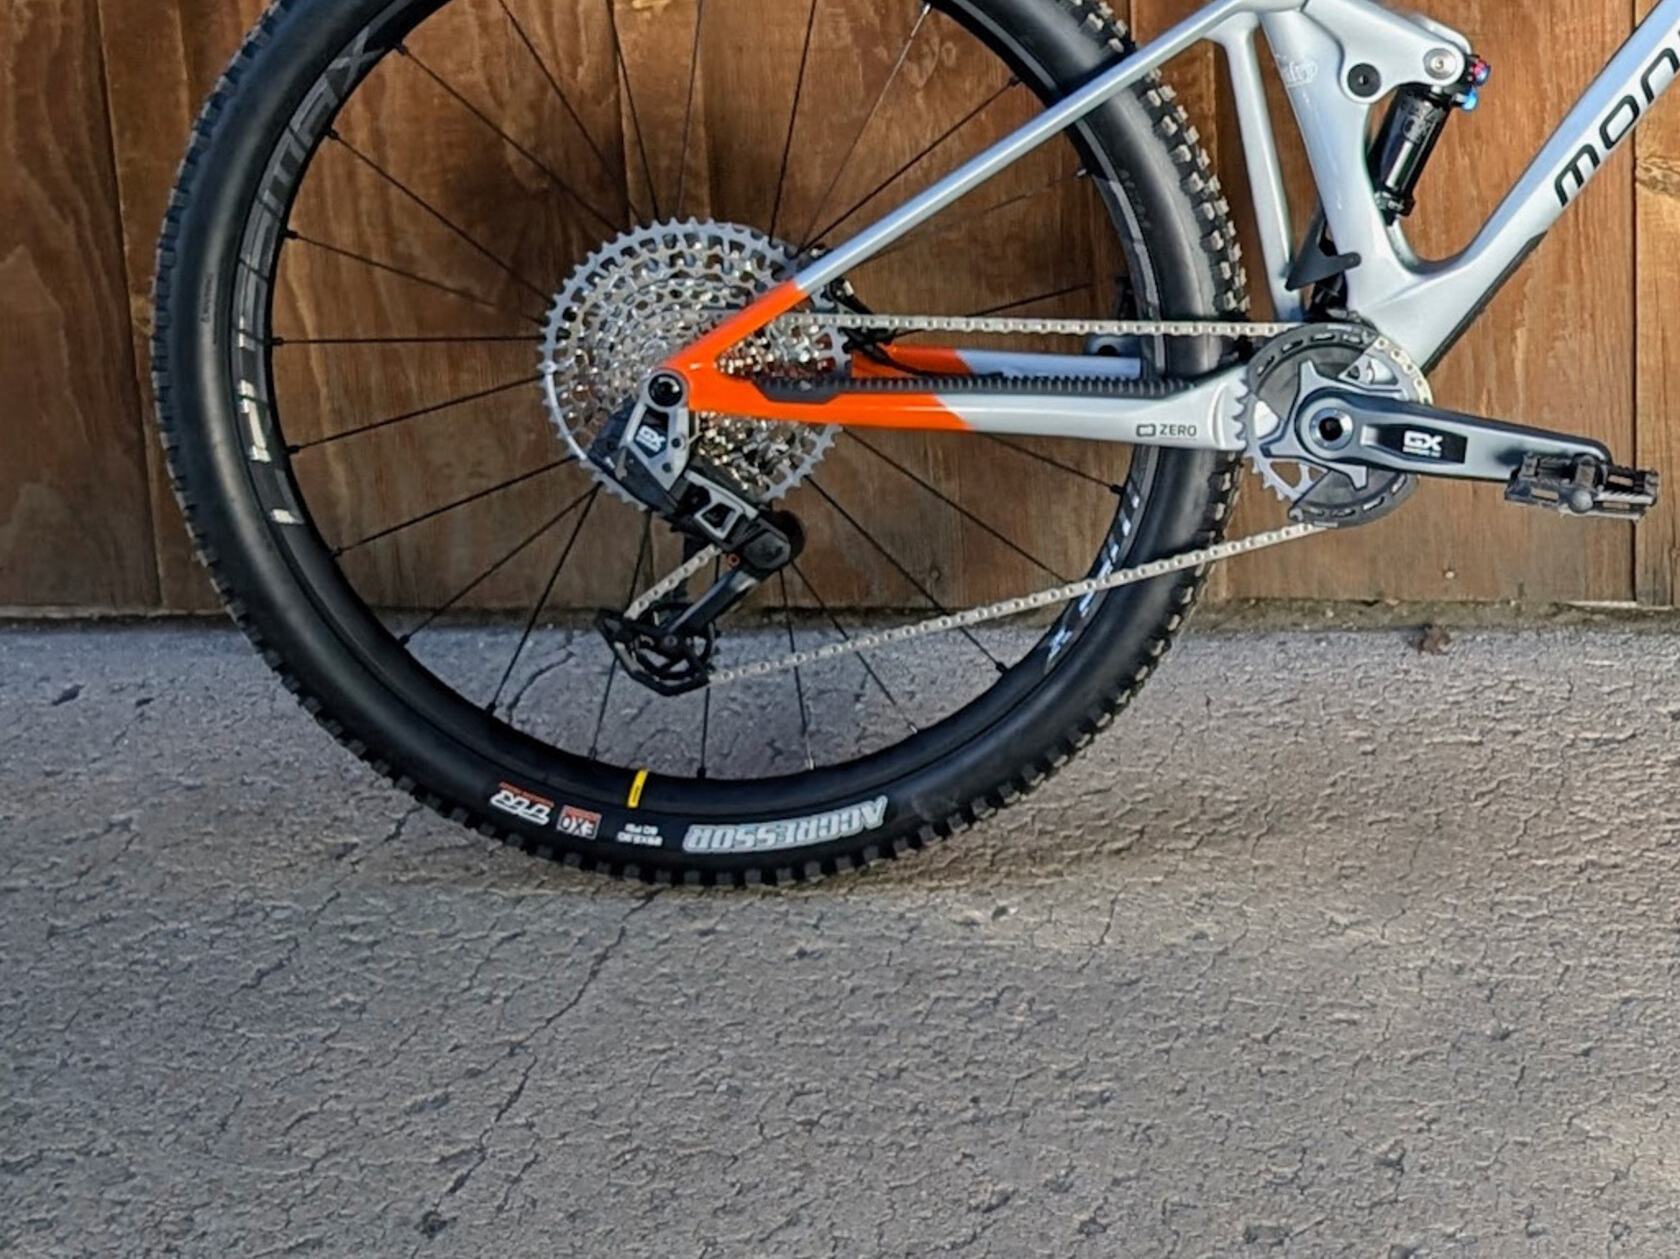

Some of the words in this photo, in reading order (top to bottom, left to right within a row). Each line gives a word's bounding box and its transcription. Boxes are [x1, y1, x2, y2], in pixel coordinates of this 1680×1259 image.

[1159, 423, 1197, 437] ZERO
[1404, 430, 1444, 451] GX
[560, 815, 597, 839] EXO
[683, 796, 889, 853] AGGRESSOR
